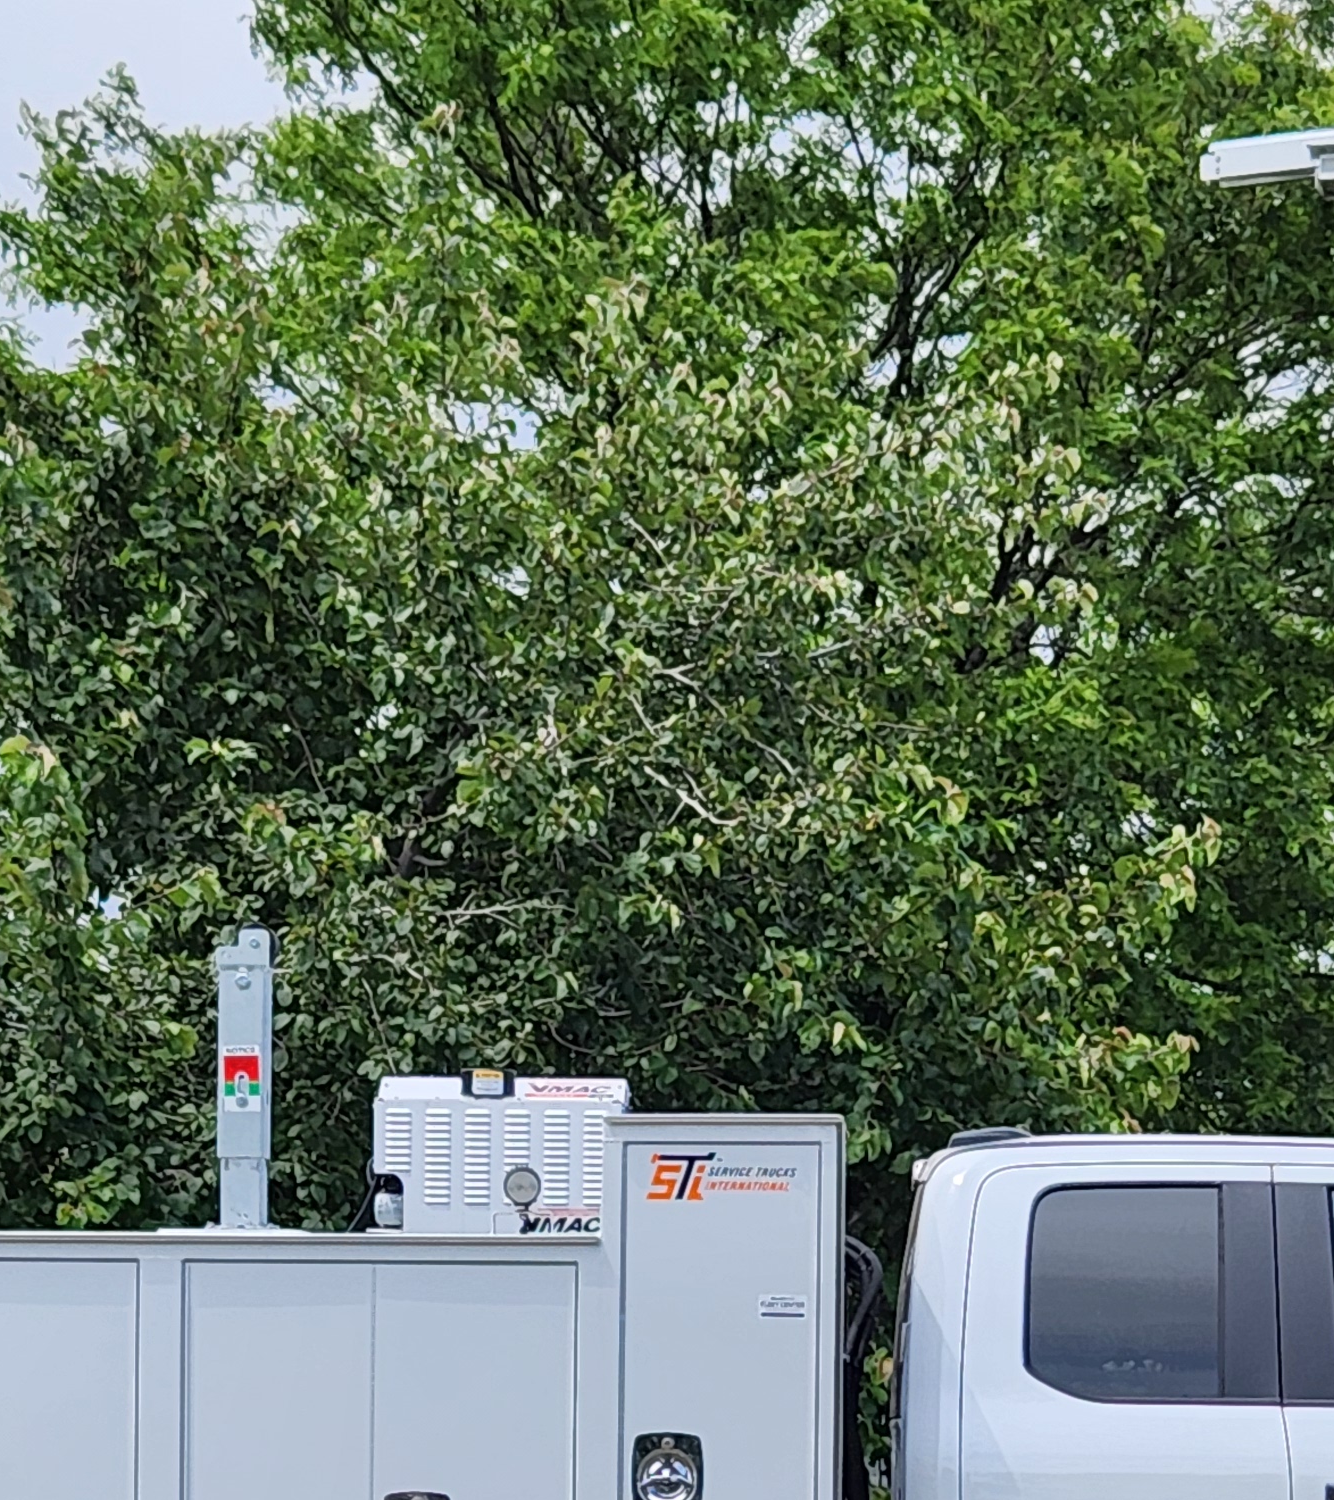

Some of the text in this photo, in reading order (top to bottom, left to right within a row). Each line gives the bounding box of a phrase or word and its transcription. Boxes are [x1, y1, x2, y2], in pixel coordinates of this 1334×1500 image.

[527, 1082, 612, 1093] VMAC
[707, 1167, 797, 1178] SERVICE TRUCKS
[704, 1181, 790, 1192] INTERNATIONAL
